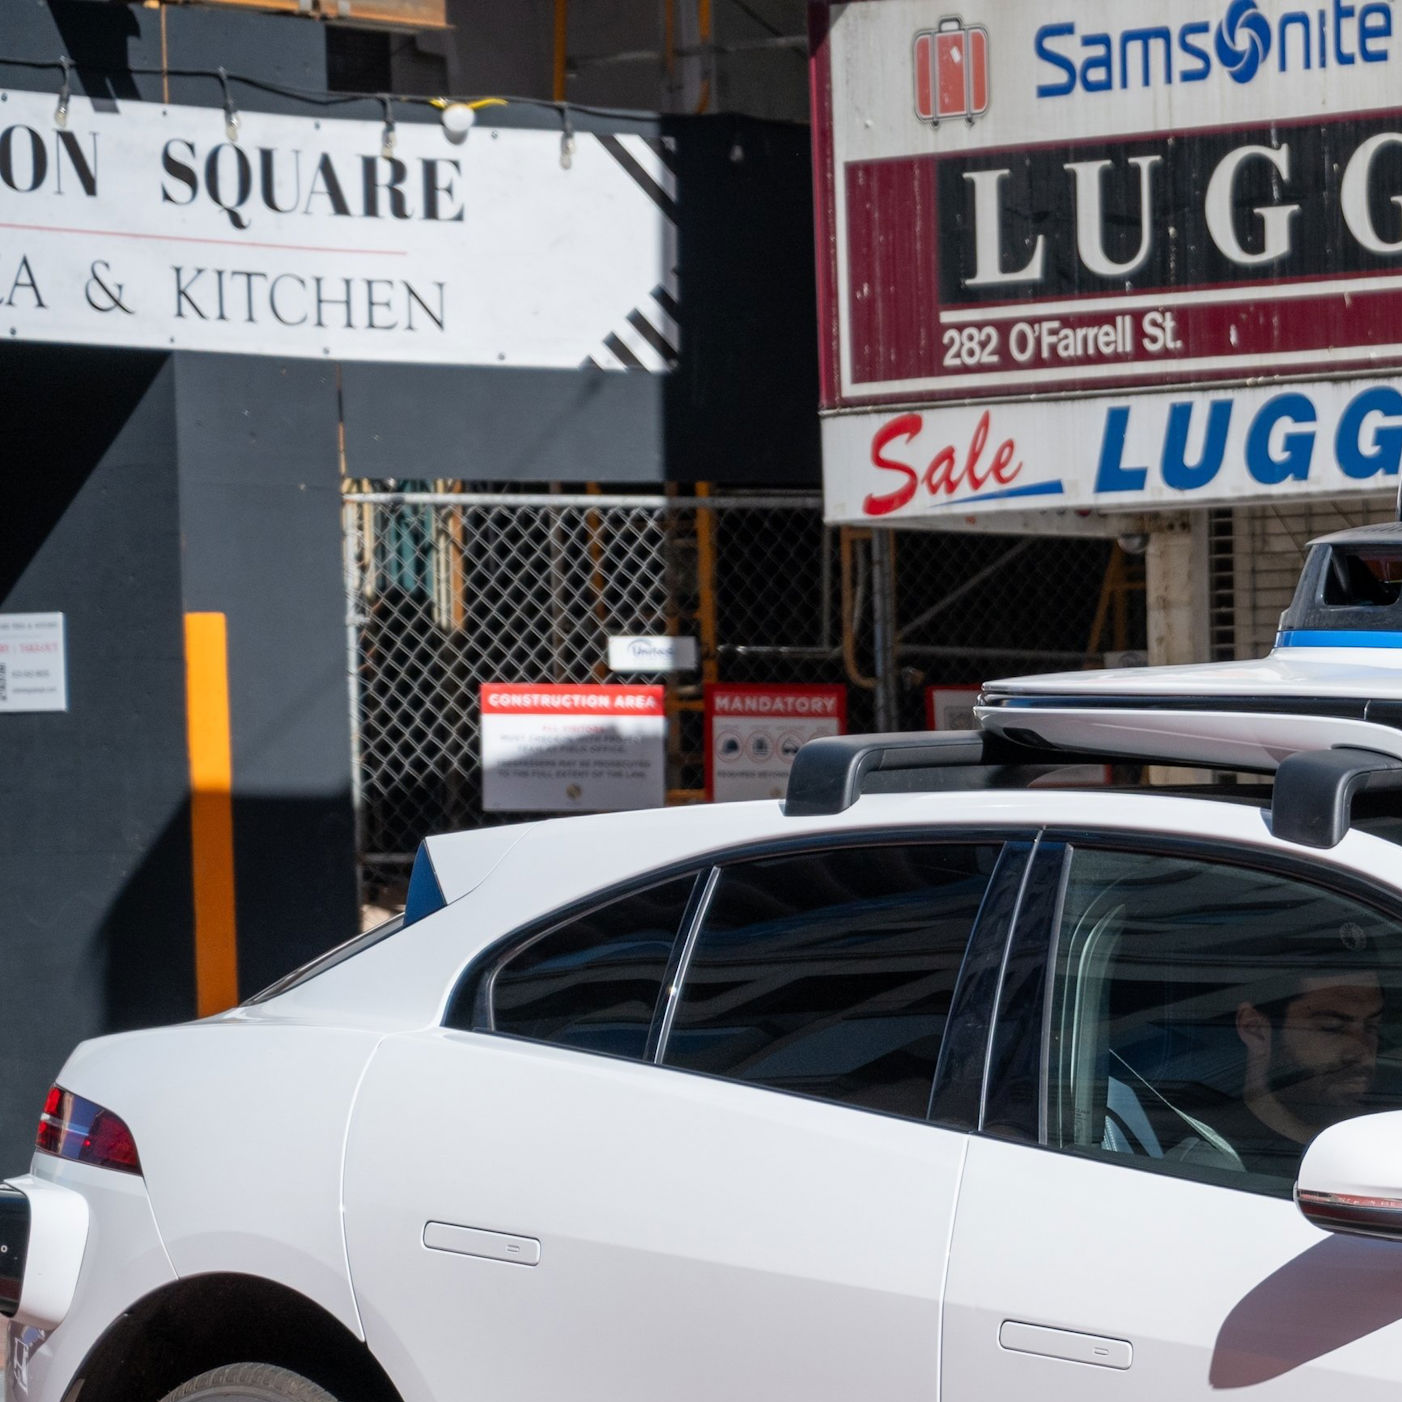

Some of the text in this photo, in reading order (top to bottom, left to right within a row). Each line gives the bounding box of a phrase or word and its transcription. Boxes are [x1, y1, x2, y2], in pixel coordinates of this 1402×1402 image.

[1034, 0, 1391, 99] Samsonite
[161, 138, 465, 229] SQUARE
[85, 260, 135, 315] &
[171, 264, 447, 333] KITCHEN
[943, 311, 1182, 367] 282 O'Farrell St.
[862, 409, 1023, 517] Sale
[488, 693, 657, 709] CONSTRUCTION AREA
[714, 696, 837, 712] MANDATORY
